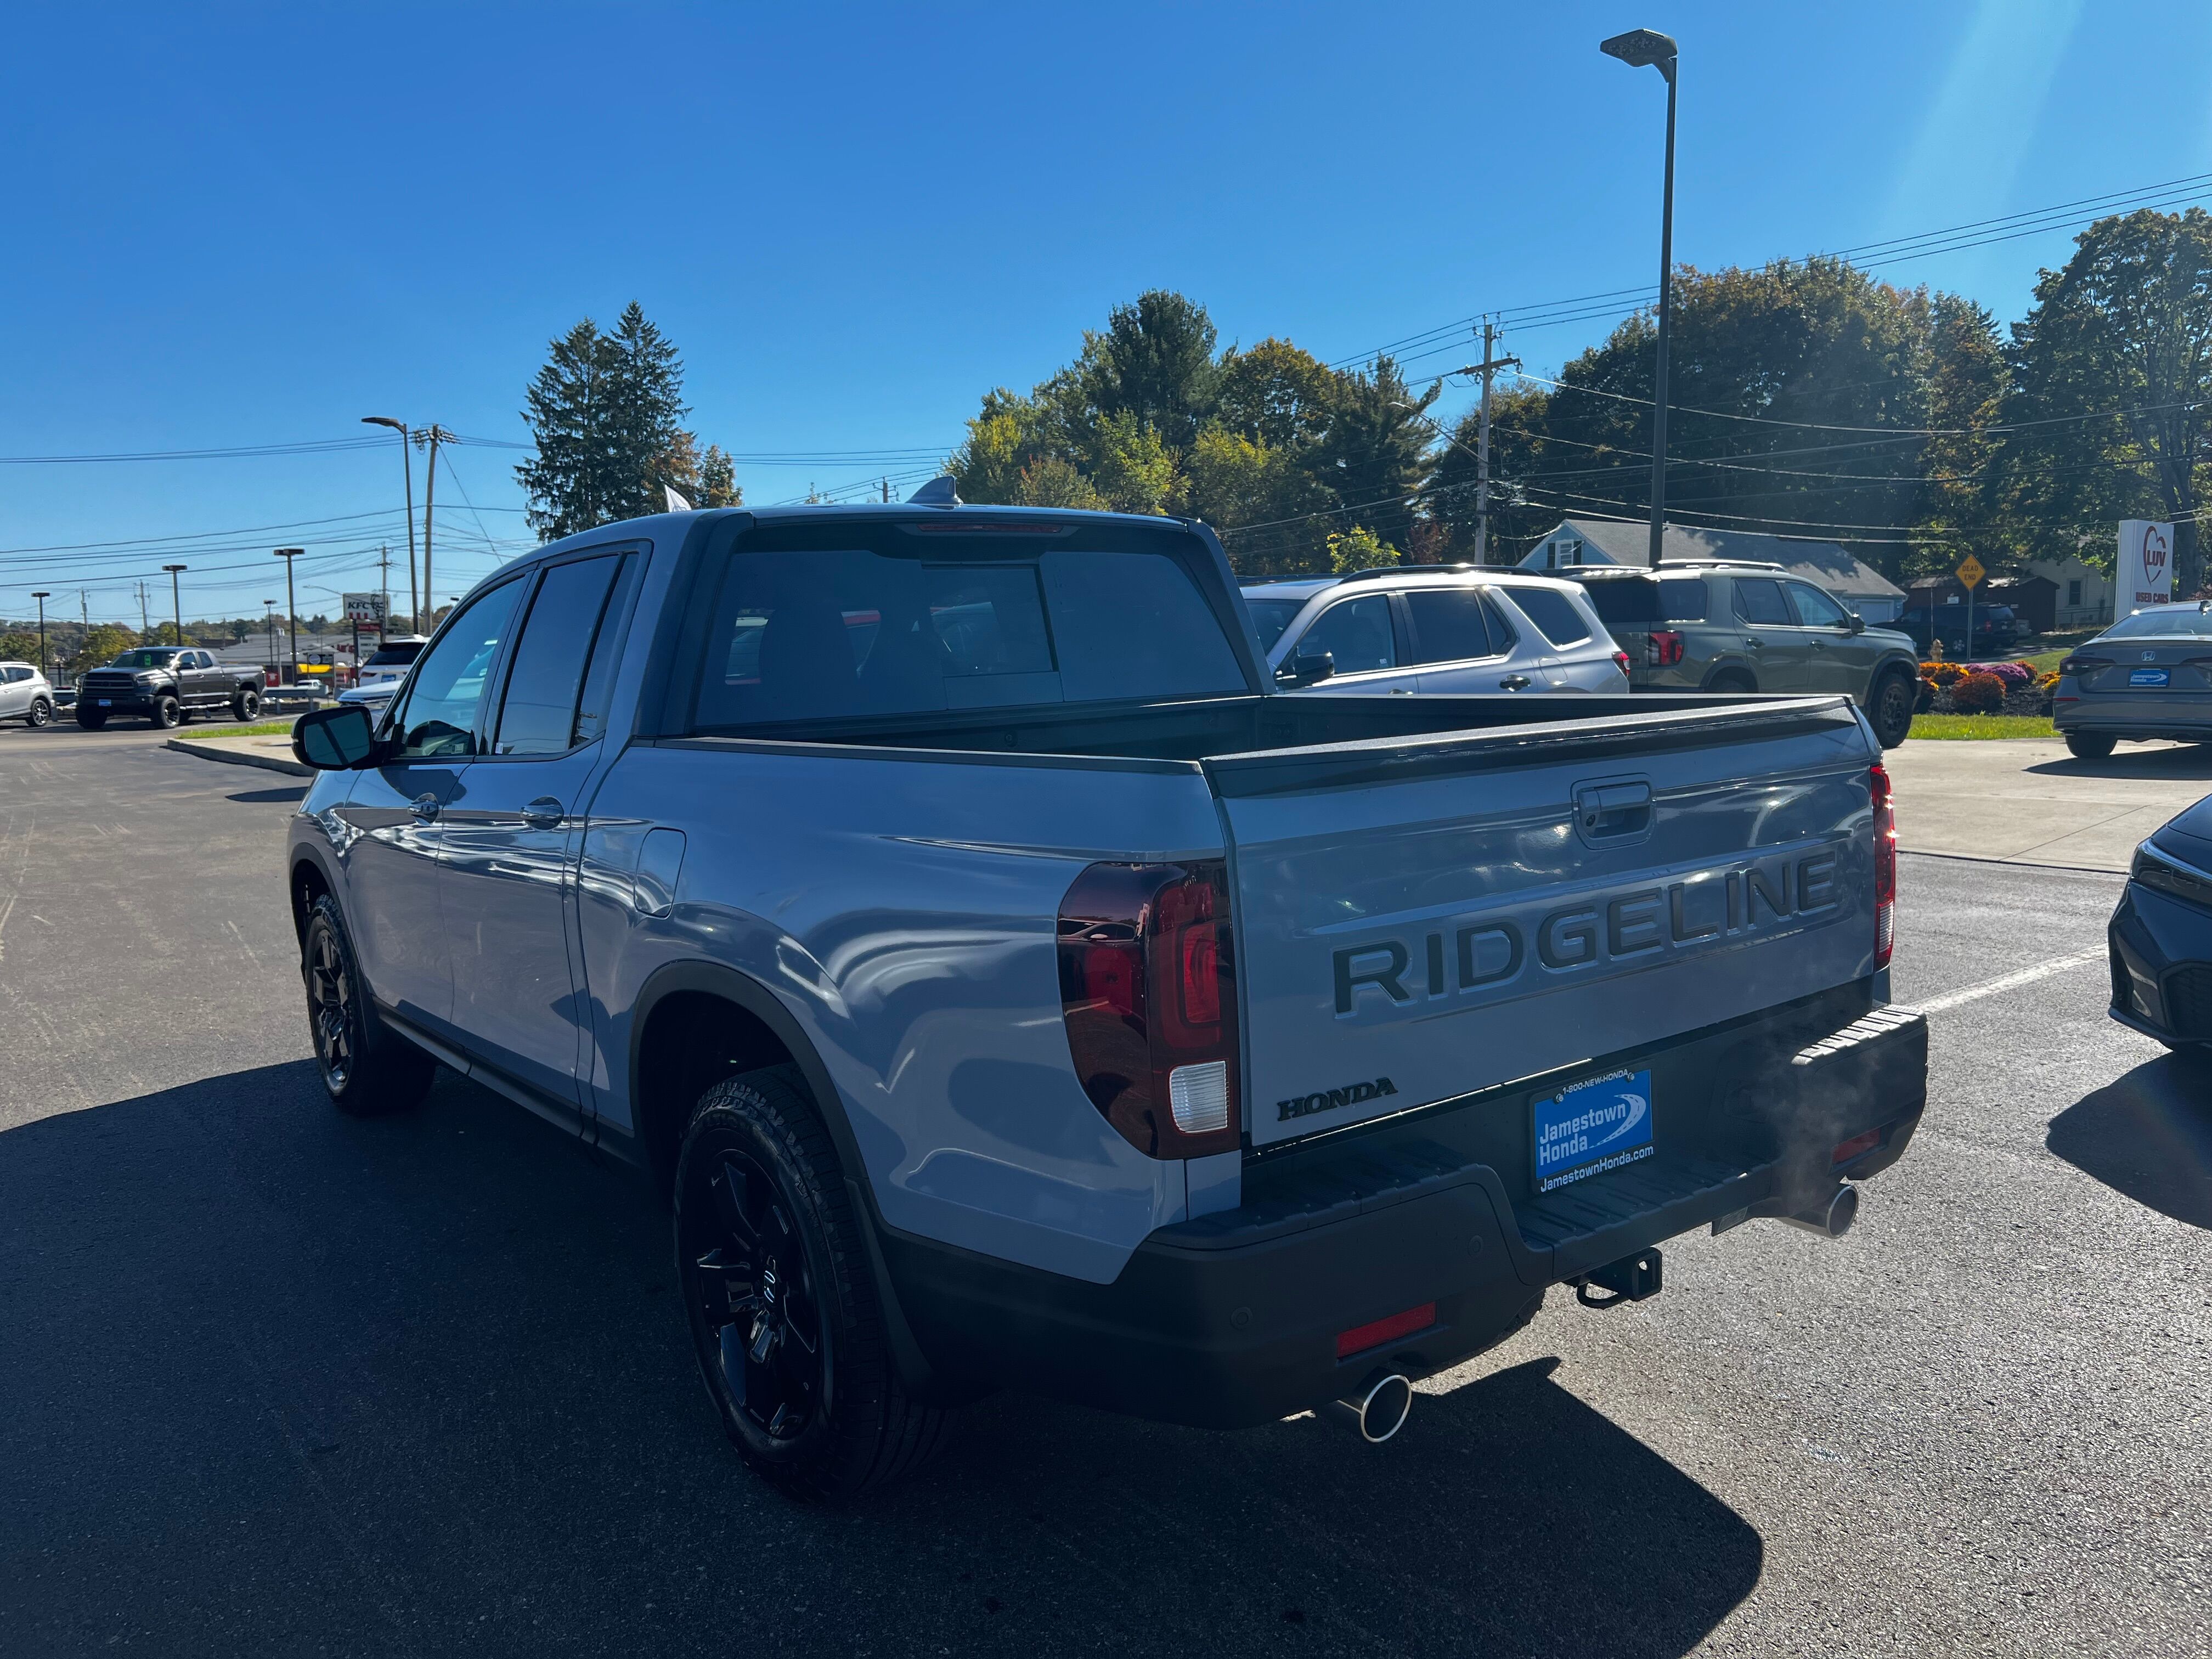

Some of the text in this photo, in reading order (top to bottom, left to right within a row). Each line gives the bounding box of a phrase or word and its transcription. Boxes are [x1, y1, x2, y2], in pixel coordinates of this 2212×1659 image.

[2147, 550, 2166, 567] LUV
[348, 601, 369, 610] KFC
[2135, 592, 2169, 603] USED CARS
[1333, 851, 1837, 1015] RIDGELINE
[1277, 1076, 1398, 1121] HONDA
[1562, 1069, 1628, 1095] 1-800-NEW-HONDA
[1539, 1103, 1626, 1144] Jamestown
[1539, 1132, 1588, 1166] Honda
[1541, 1145, 1654, 1193] JamestownHonda.com
